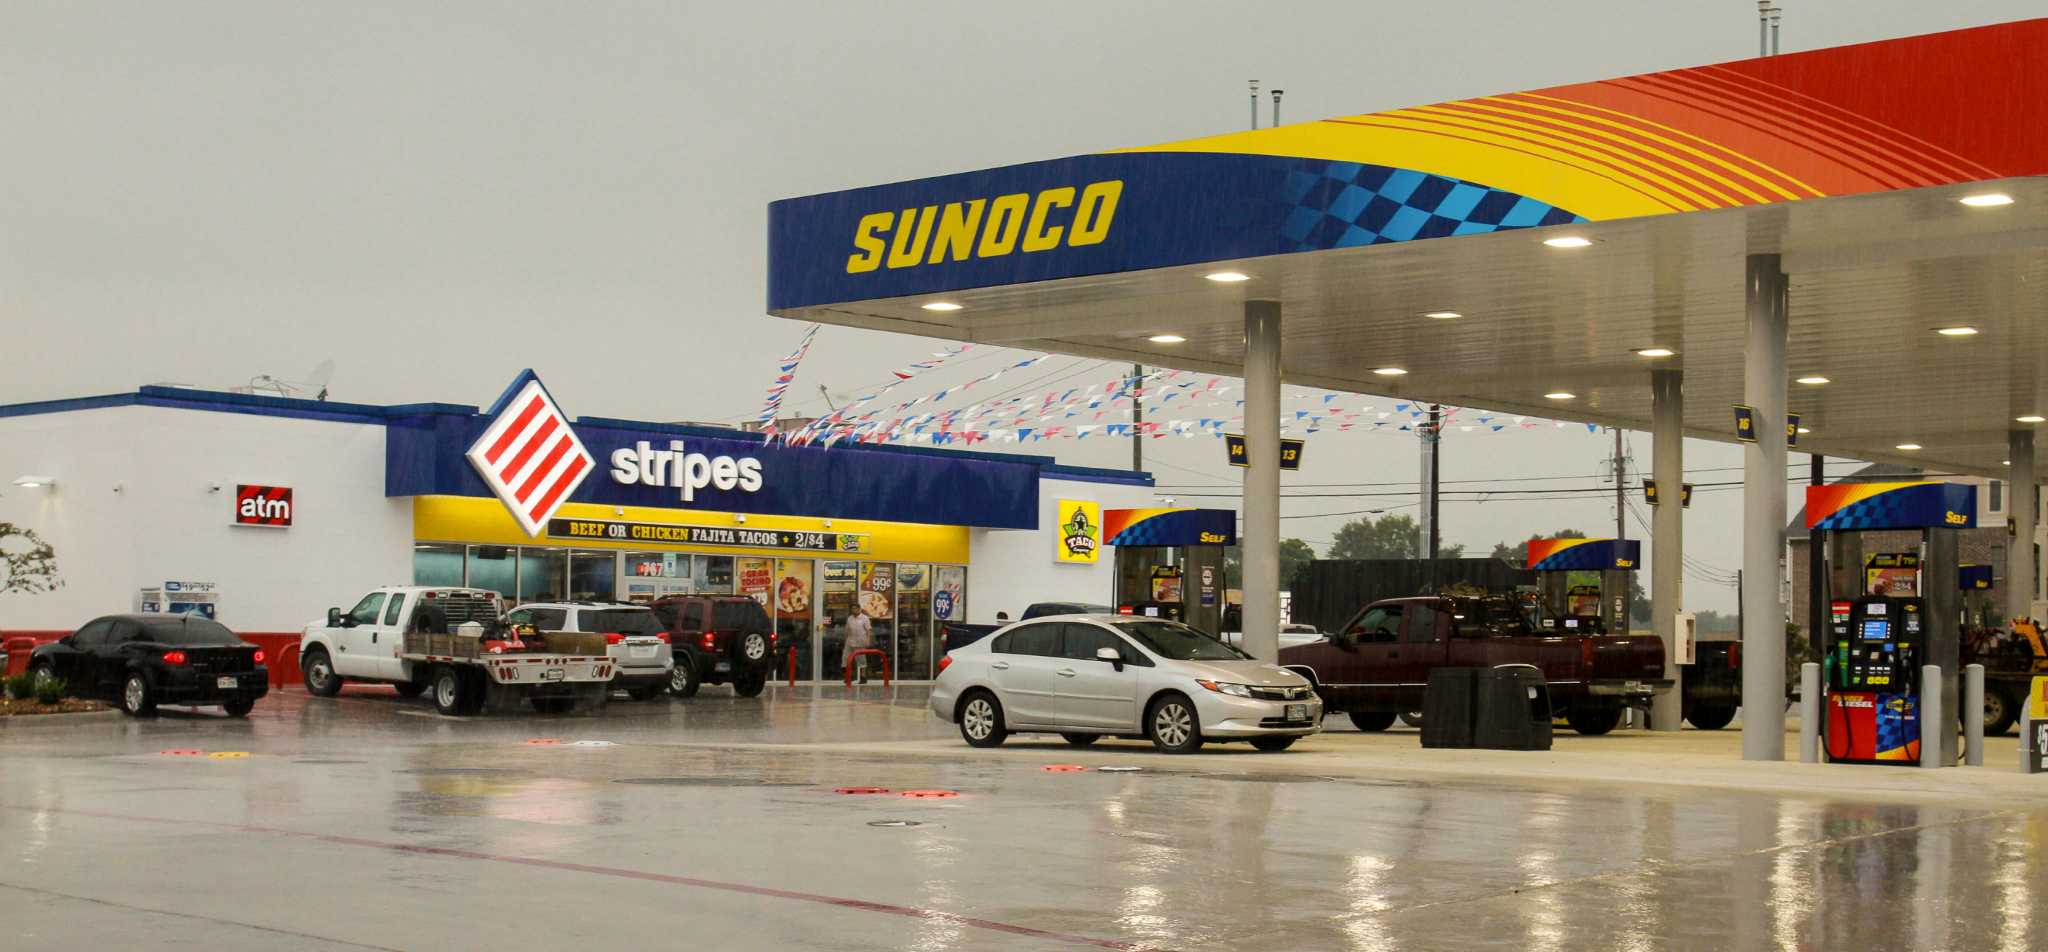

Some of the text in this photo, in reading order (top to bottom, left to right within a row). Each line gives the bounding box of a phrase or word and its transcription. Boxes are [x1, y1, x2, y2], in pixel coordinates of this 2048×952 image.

[846, 180, 1124, 274] SUNOCO
[1231, 444, 1243, 456] 14
[1282, 449, 1296, 460] 13
[610, 440, 763, 501] stripes
[240, 495, 289, 519] atm
[570, 522, 605, 537] BEEF
[608, 524, 627, 538] OR
[632, 525, 689, 541] CHICKEN
[692, 528, 735, 543] FAJITA
[738, 530, 778, 545] TACOS
[795, 532, 825, 549] 2/$4
[1067, 536, 1095, 550] TACO
